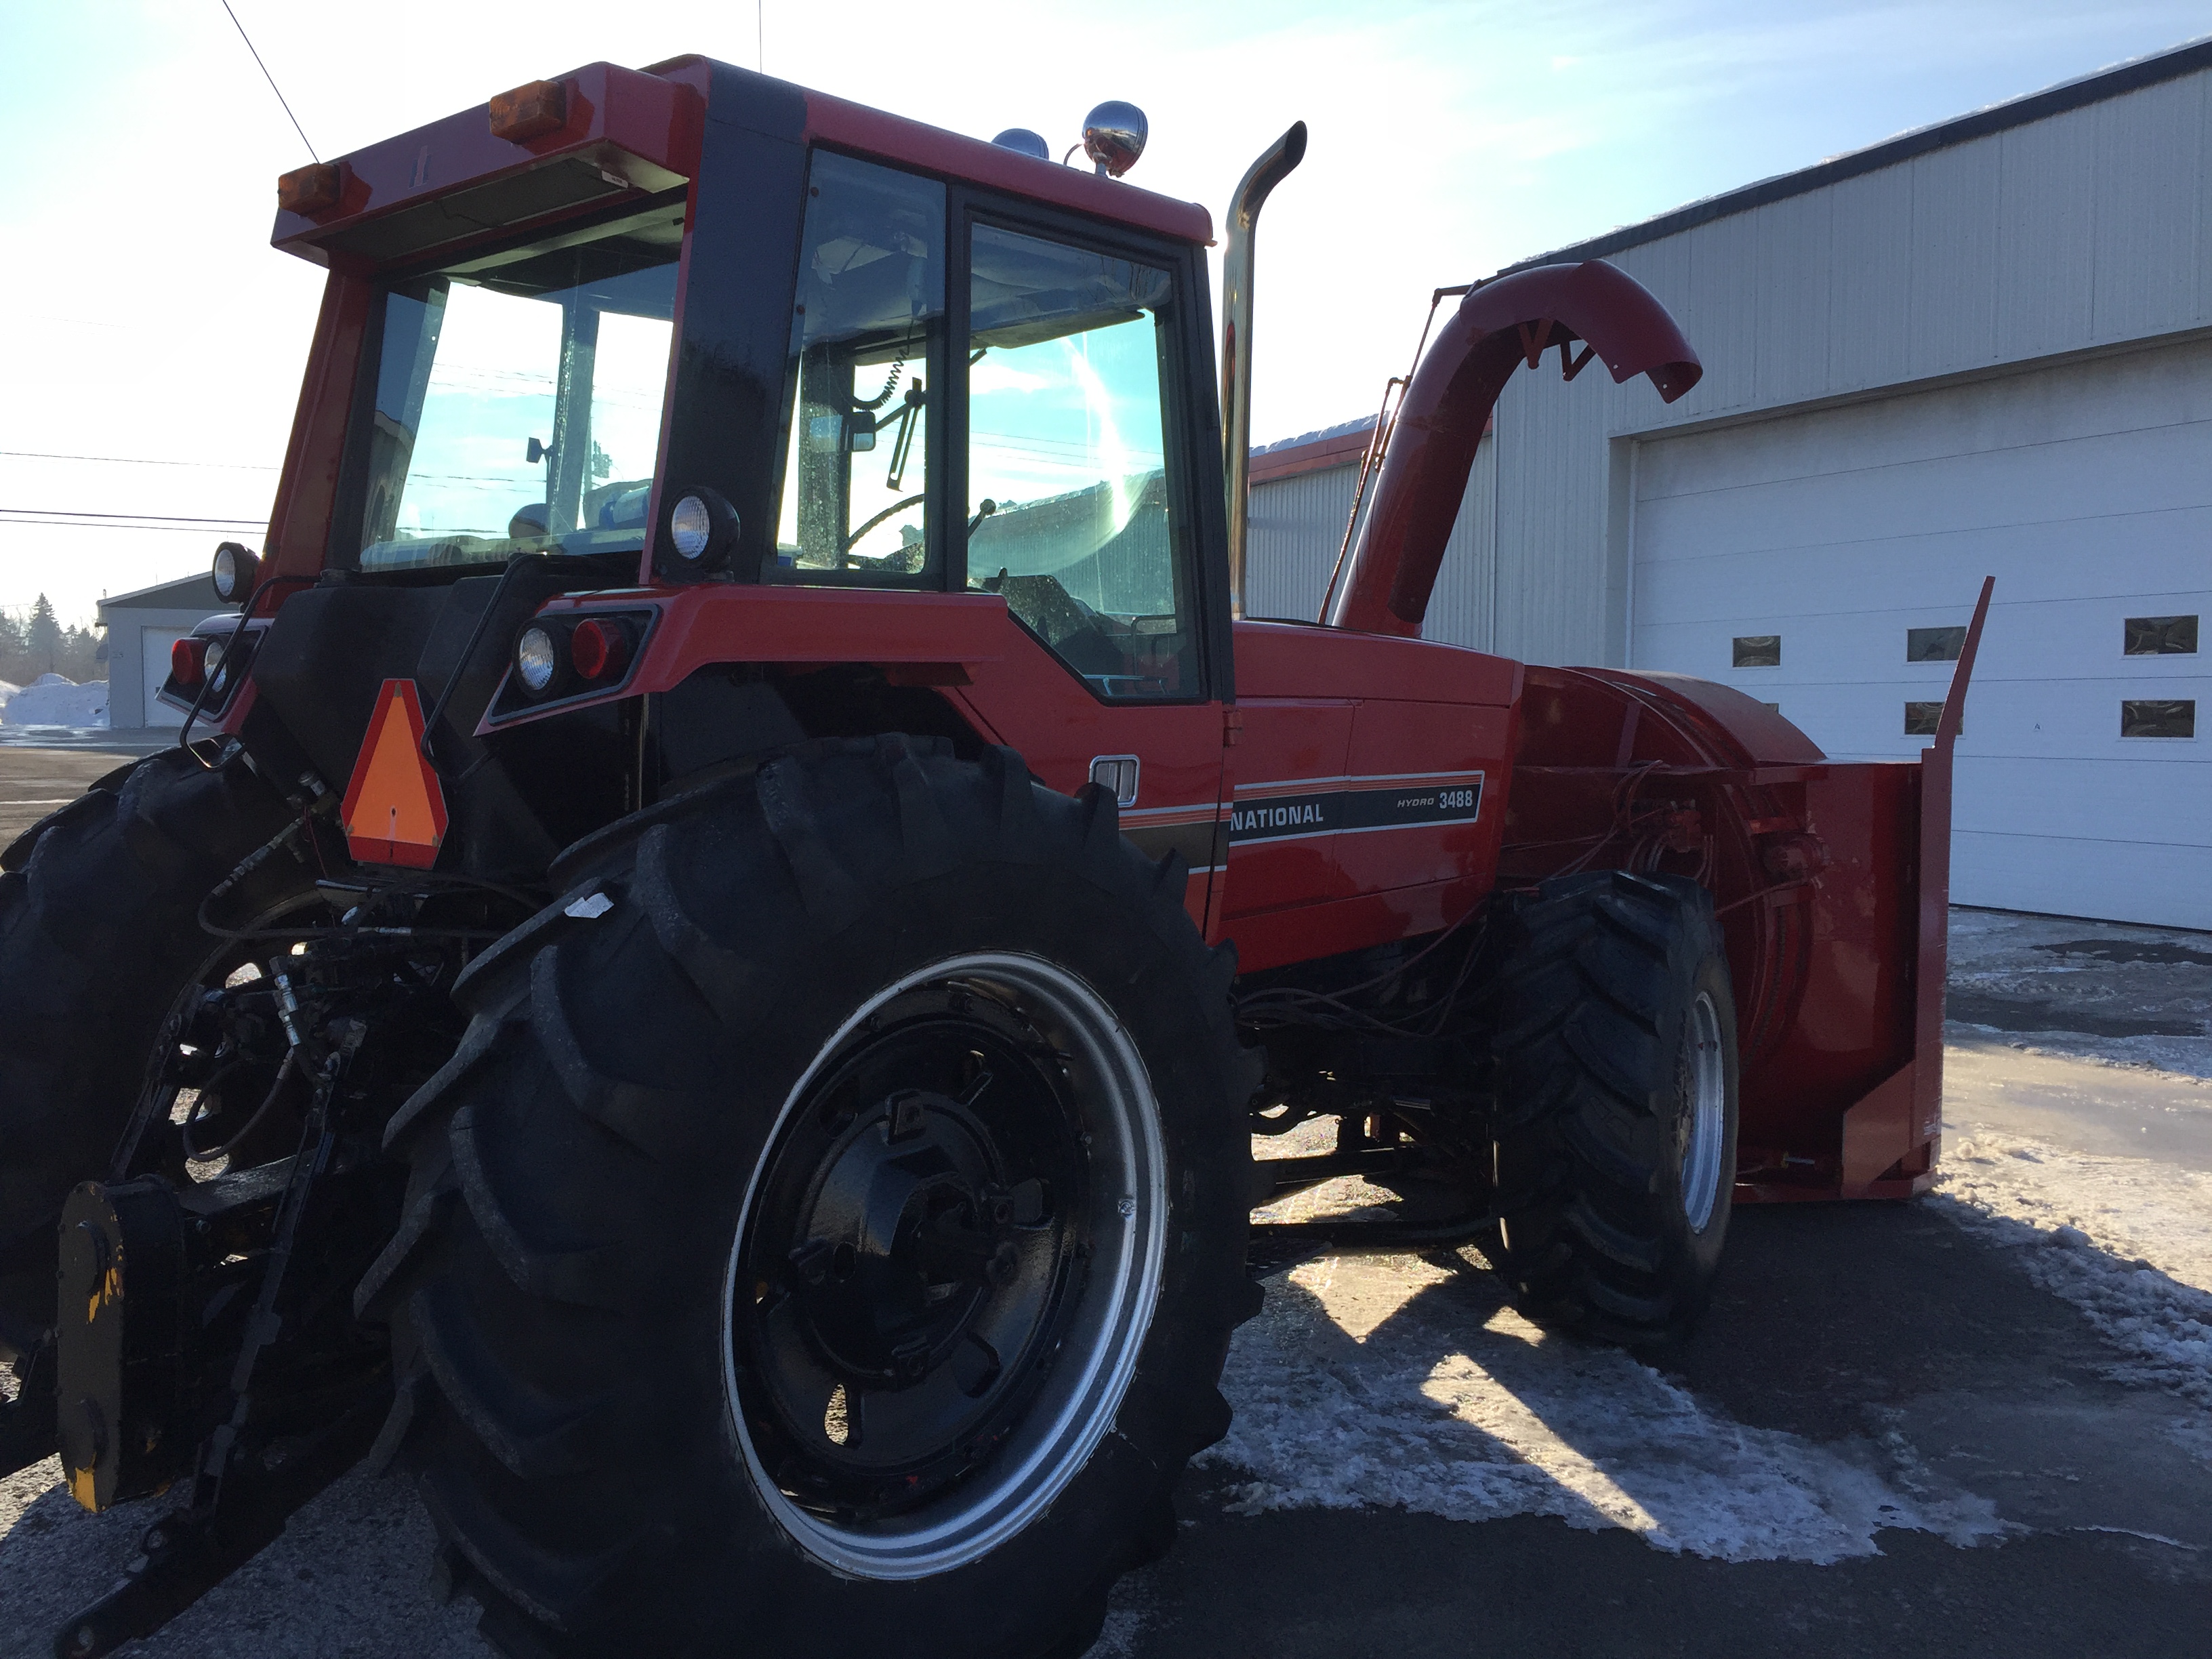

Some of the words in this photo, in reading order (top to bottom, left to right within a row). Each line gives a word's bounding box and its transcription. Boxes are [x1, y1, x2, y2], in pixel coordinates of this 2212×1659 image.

[1230, 804, 1324, 832] NATIONAL
[1397, 798, 1435, 808] HYDRO
[1439, 790, 1473, 809] 3488
